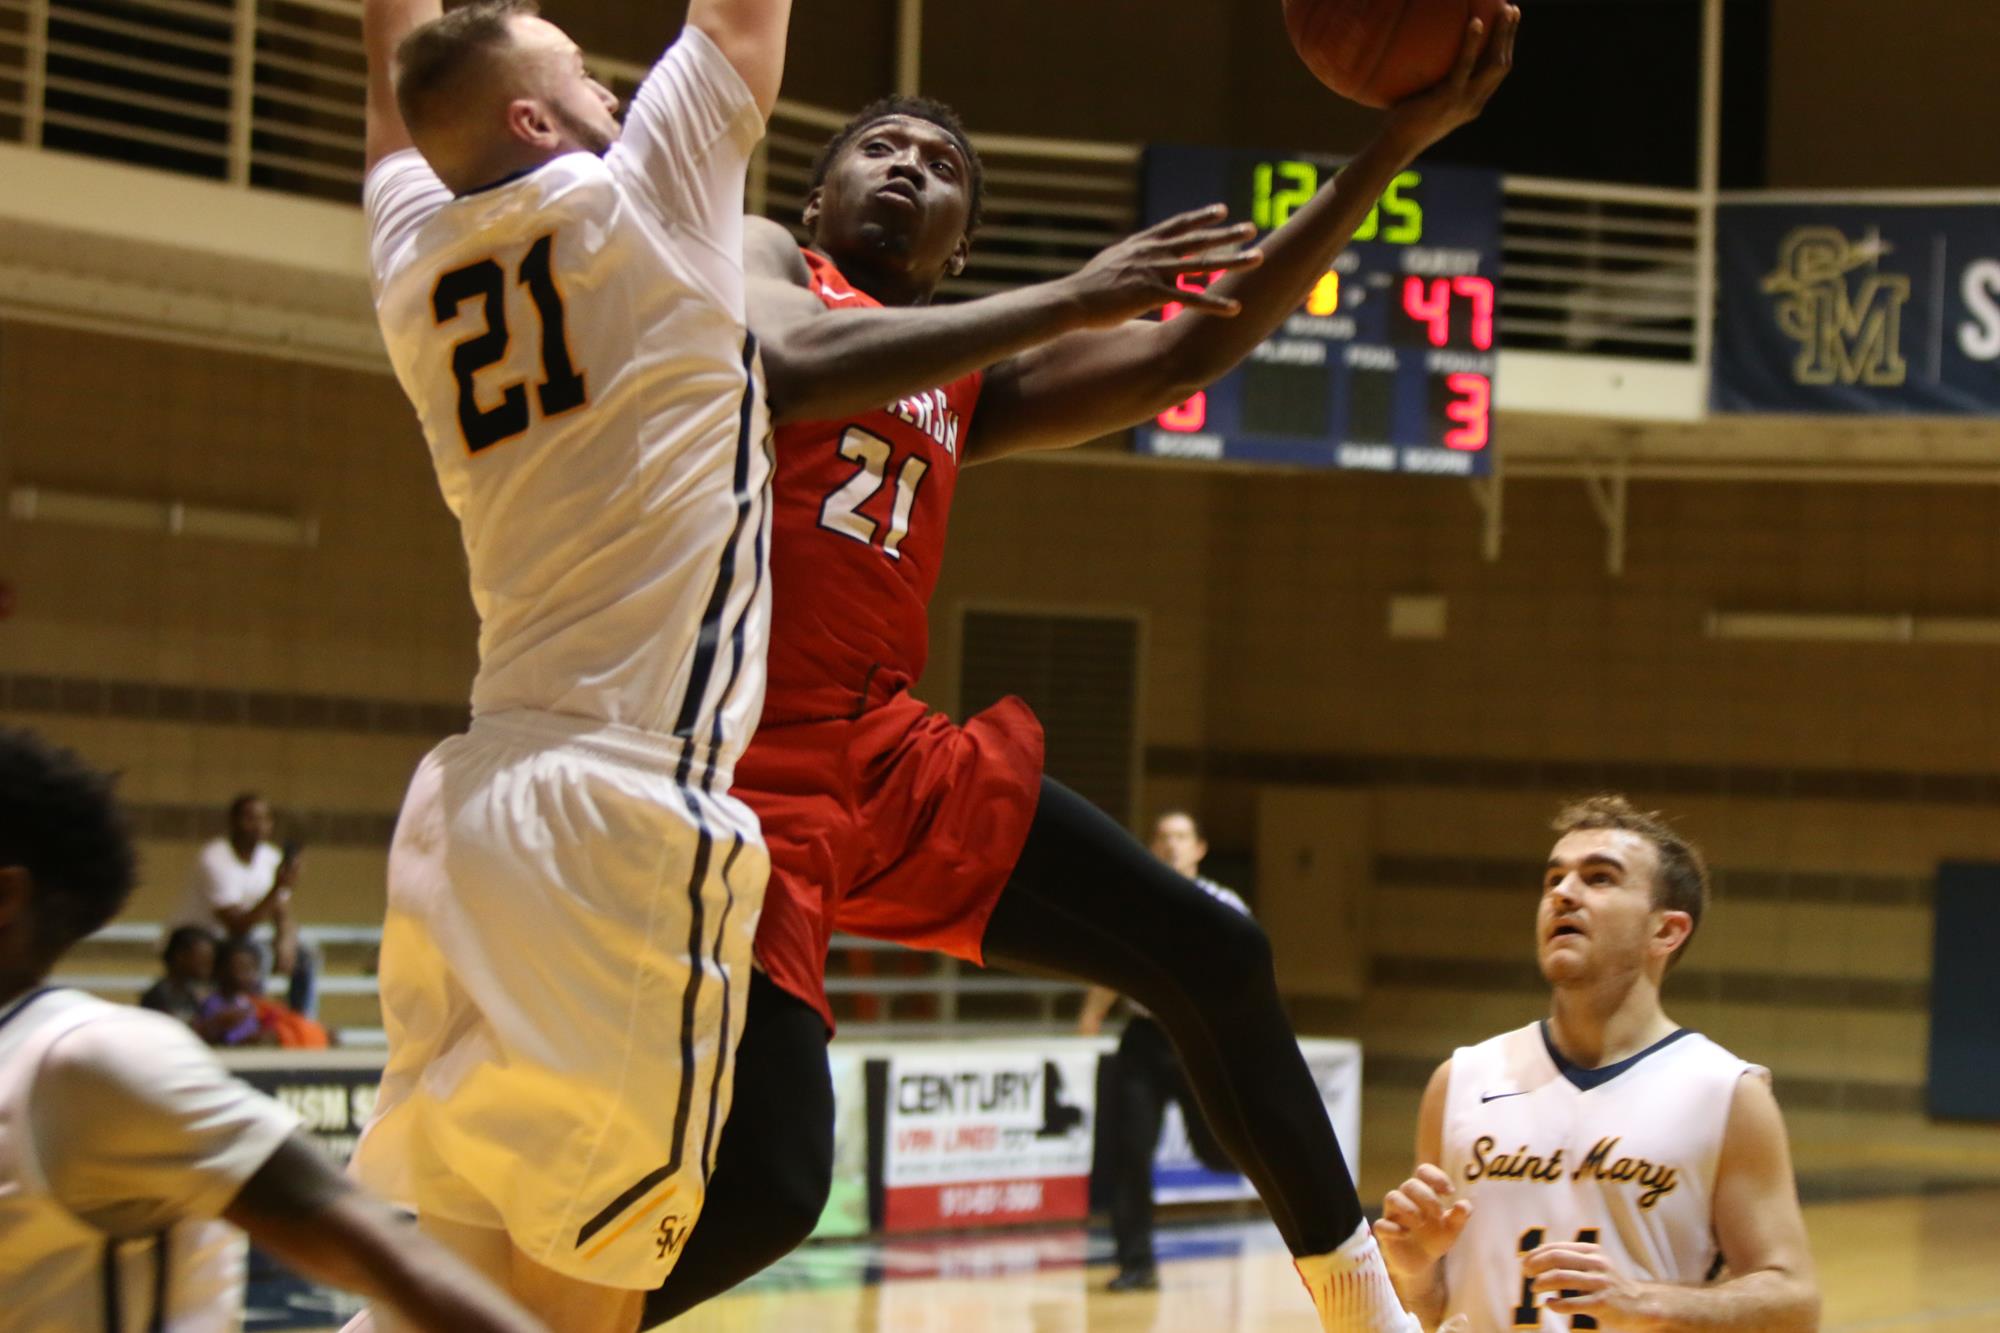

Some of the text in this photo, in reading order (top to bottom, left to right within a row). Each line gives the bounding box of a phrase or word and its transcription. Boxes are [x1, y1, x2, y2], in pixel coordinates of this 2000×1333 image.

[430, 230, 590, 457] 21
[1402, 275, 1495, 350] 47
[1444, 373, 1491, 451] 3
[817, 424, 931, 560] 21
[899, 1072, 1037, 1114] CENTURY
[1465, 1135, 1680, 1209] Saint Mary
